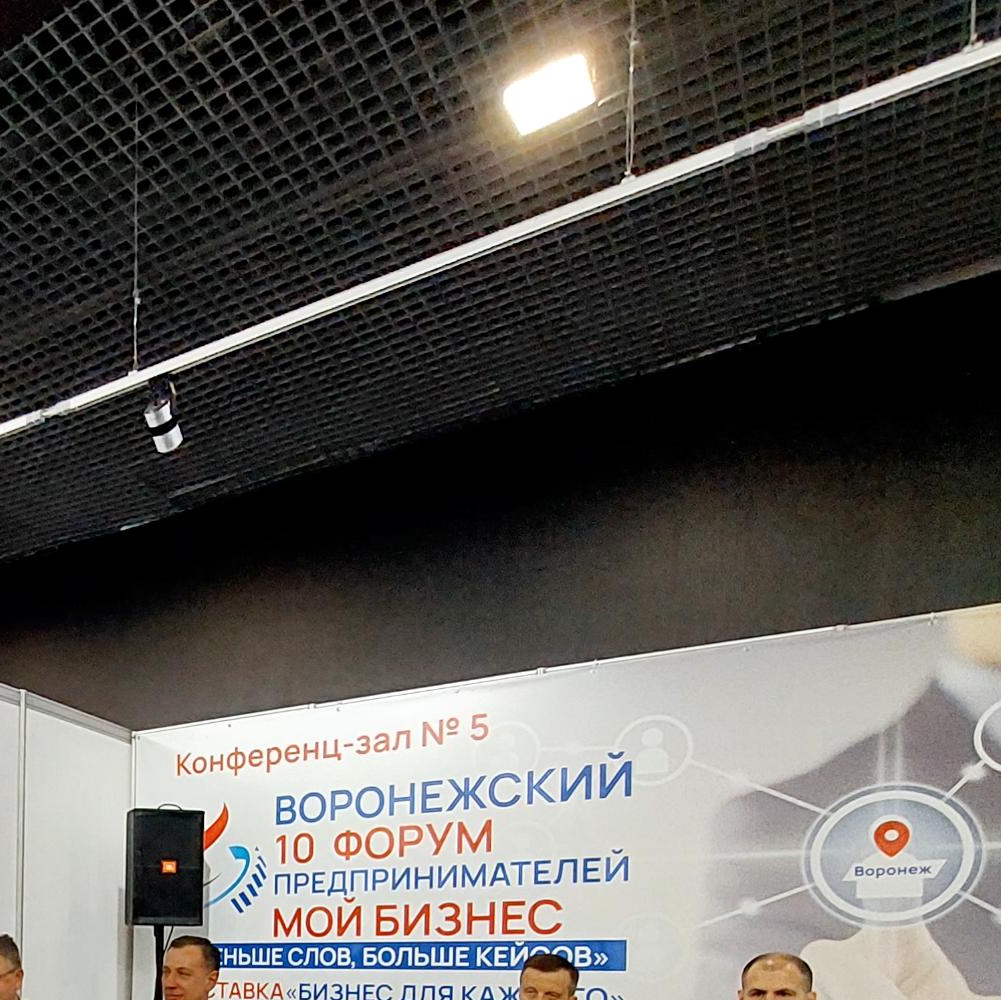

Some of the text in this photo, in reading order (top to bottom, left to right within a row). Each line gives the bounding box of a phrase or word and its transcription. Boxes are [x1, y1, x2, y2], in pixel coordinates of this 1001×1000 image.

[176, 713, 489, 777] Конференц-зал № 5
[274, 751, 633, 826] ВОРОНЕЖСКИЙ
[274, 818, 493, 865] 10 ФОРУМ
[273, 848, 630, 897] ПРЕДПРИНИМАТЕЛЕЙ
[854, 865, 932, 879] Воронеж
[272, 896, 564, 939] МОЙ БИЗНЕС
[287, 946, 356, 969] СЛОВ,
[362, 946, 470, 968] БОЛЬШЕ
[207, 981, 284, 1000] ТАВКА
